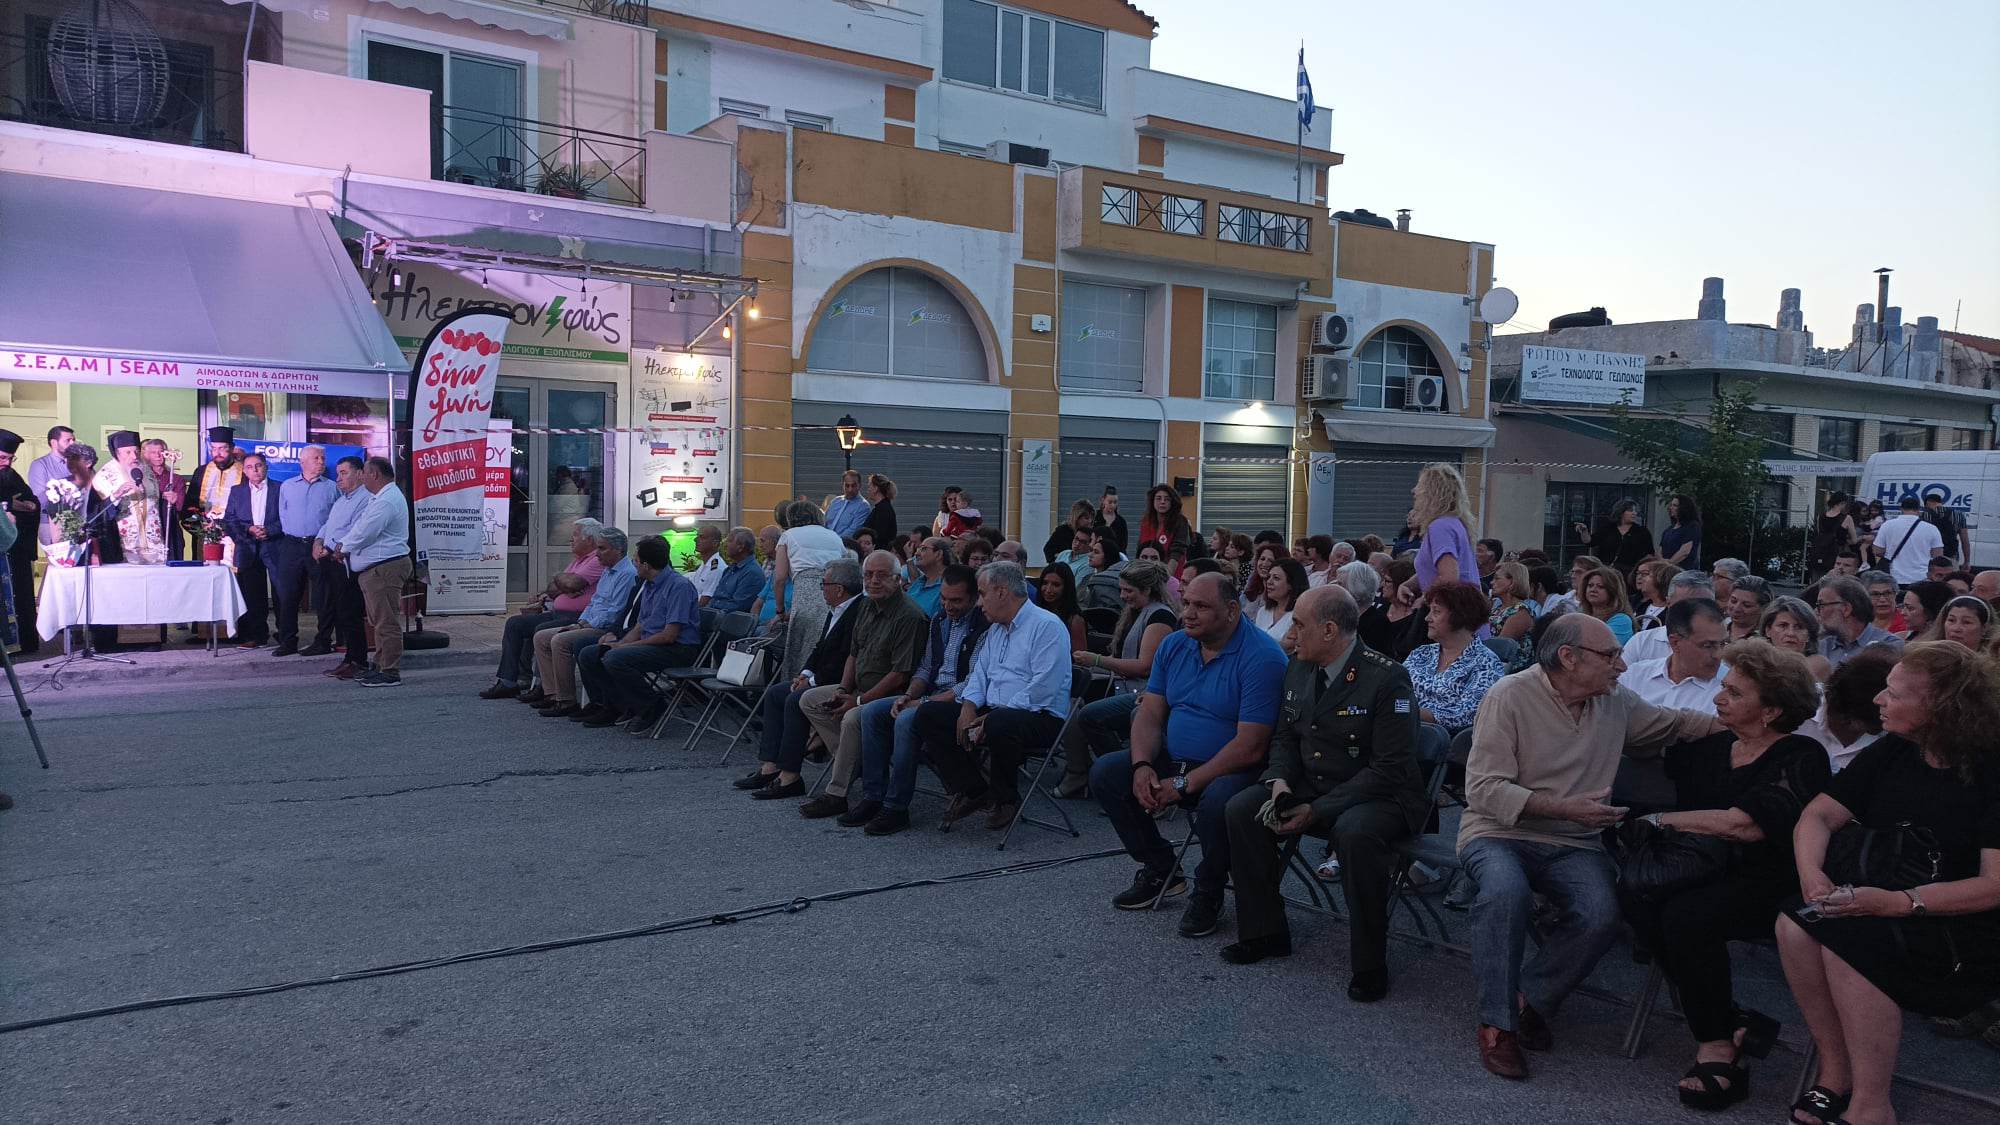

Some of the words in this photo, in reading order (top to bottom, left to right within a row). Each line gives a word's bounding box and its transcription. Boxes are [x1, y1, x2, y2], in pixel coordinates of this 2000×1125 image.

[381, 263, 548, 326] Ήλεκον
[563, 296, 621, 344] φώς
[14, 354, 98, 372] Σ.Ε.Α.Μ
[120, 360, 179, 376] SEAM
[196, 368, 259, 379] ΑΙΜΟΔΟΤΩΝ
[262, 371, 269, 379] &
[271, 372, 319, 381] ΔΩΡΗΤΩΝ
[425, 352, 487, 388] δίνω
[1561, 367, 1604, 381] ΤΕΧΝΟΛΟΓΟΣ
[1609, 371, 1644, 384] ΓΕΩΠΟΝΟΣ
[196, 378, 251, 388] ΟΡΓΑΝΩΝ
[255, 381, 319, 392] ΜΥΤΙΛΗΝΗΣ
[417, 444, 477, 470] εθελοντική
[427, 467, 477, 490] αιμοδοσία
